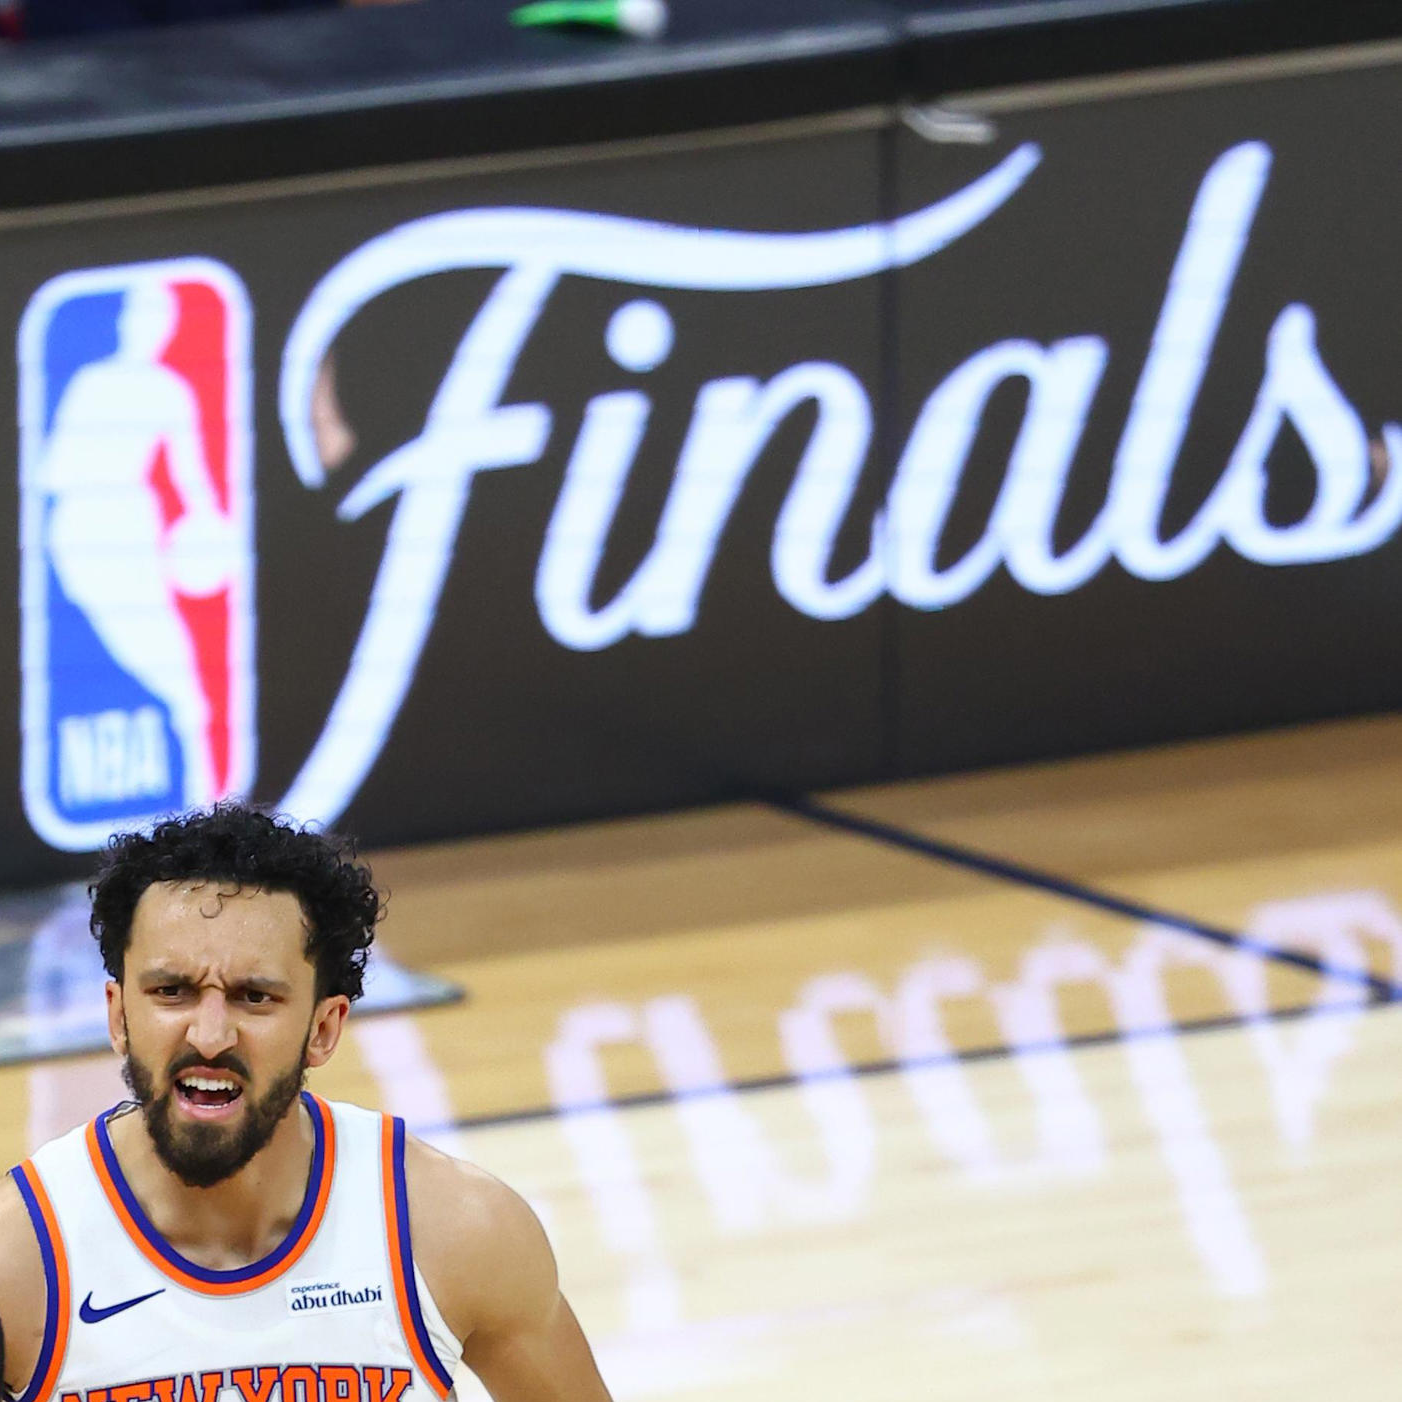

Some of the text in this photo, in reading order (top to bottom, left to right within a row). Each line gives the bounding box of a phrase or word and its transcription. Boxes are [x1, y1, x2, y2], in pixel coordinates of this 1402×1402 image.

[60, 140, 1402, 833] NBA Finals
[291, 1282, 340, 1294] experience
[291, 1285, 382, 1311] abu dhabi
